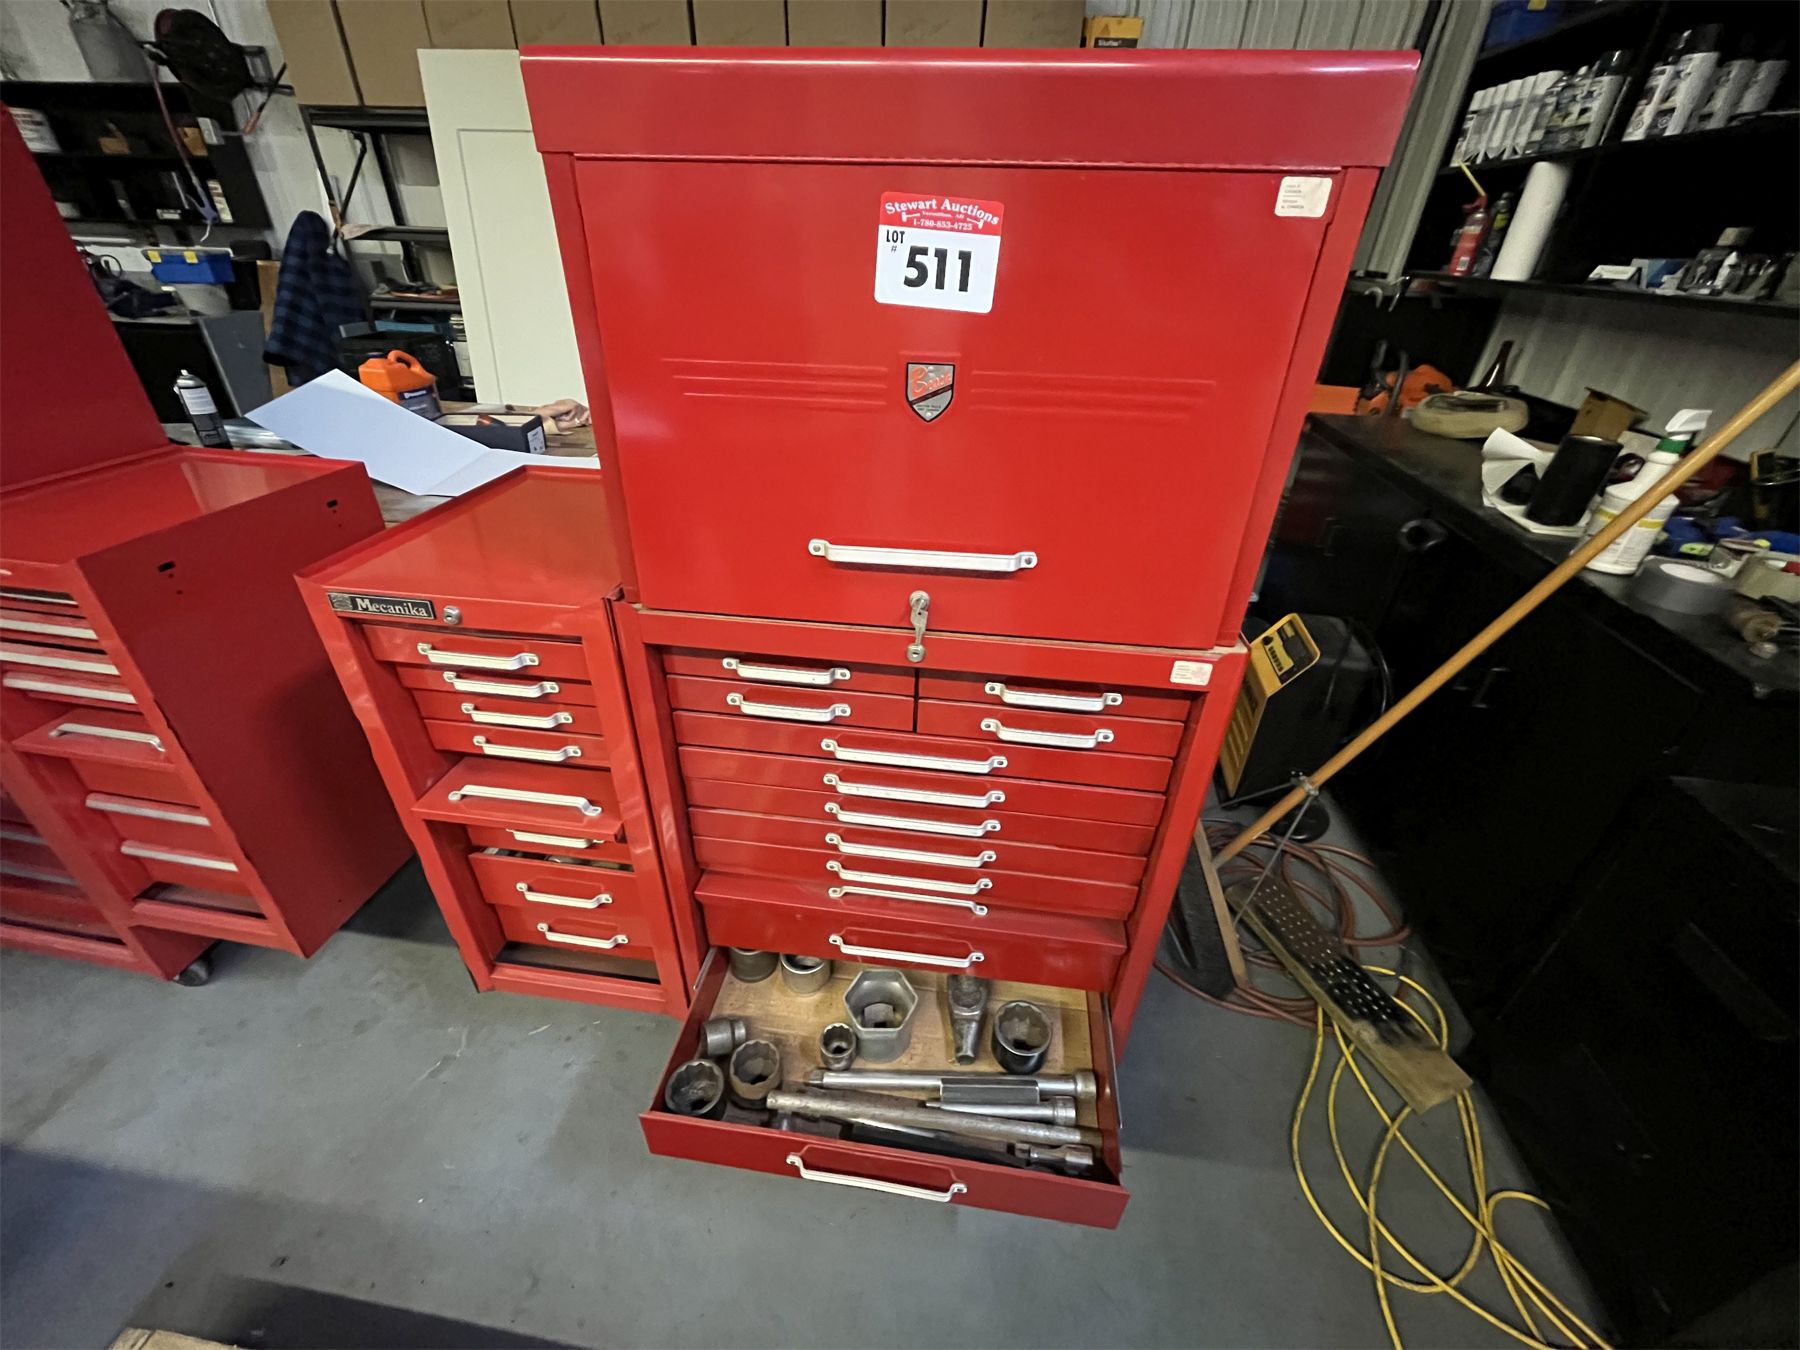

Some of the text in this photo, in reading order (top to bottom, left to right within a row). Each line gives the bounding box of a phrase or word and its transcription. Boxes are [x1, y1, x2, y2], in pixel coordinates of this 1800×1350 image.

[885, 198, 1000, 225] Stewart Auctions
[913, 218, 973, 231] 1-780-853-4725
[886, 229, 905, 244] LOT
[903, 245, 972, 292] 511
[355, 597, 429, 617] Mecanika
